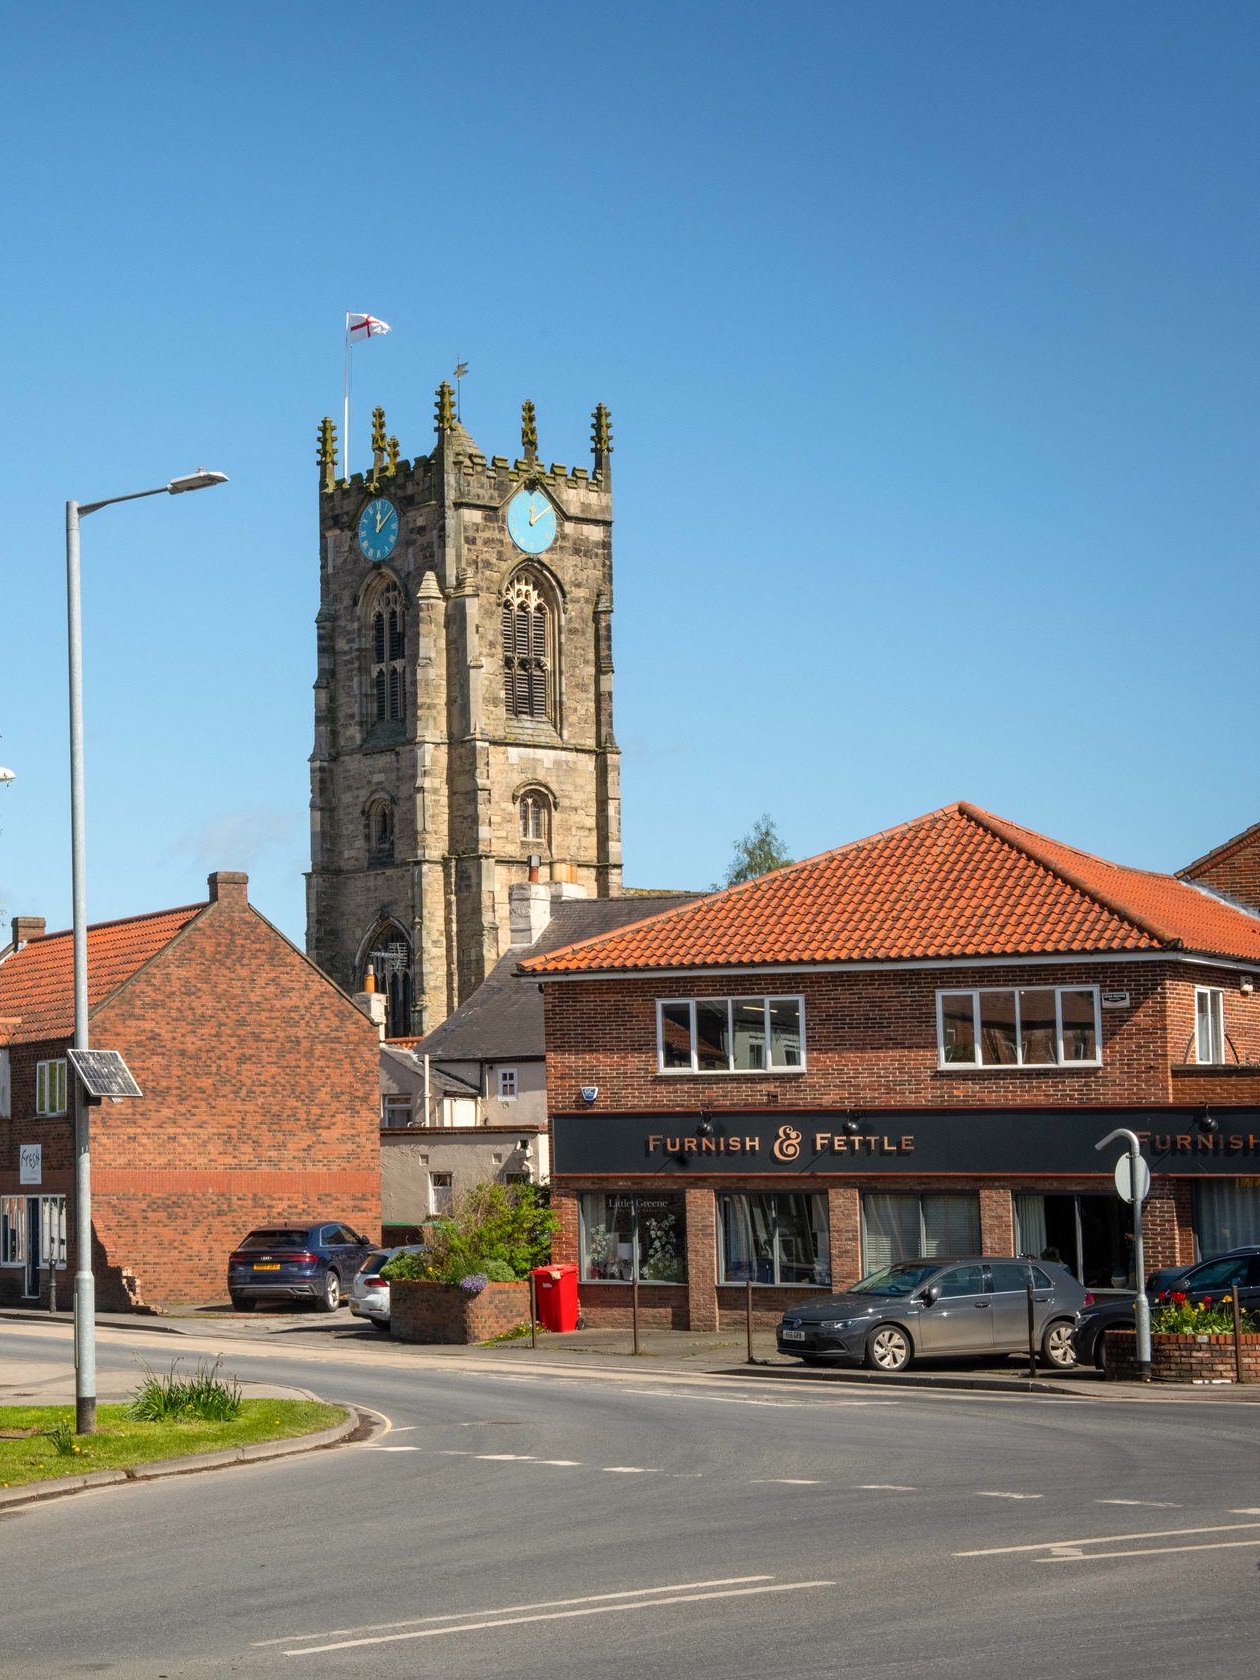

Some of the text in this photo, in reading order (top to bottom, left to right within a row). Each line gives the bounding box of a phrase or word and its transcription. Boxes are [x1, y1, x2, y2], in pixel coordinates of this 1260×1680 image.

[649, 1125, 915, 1161] FURNISH & FETTLE
[609, 1199, 668, 1207] Little Greene
